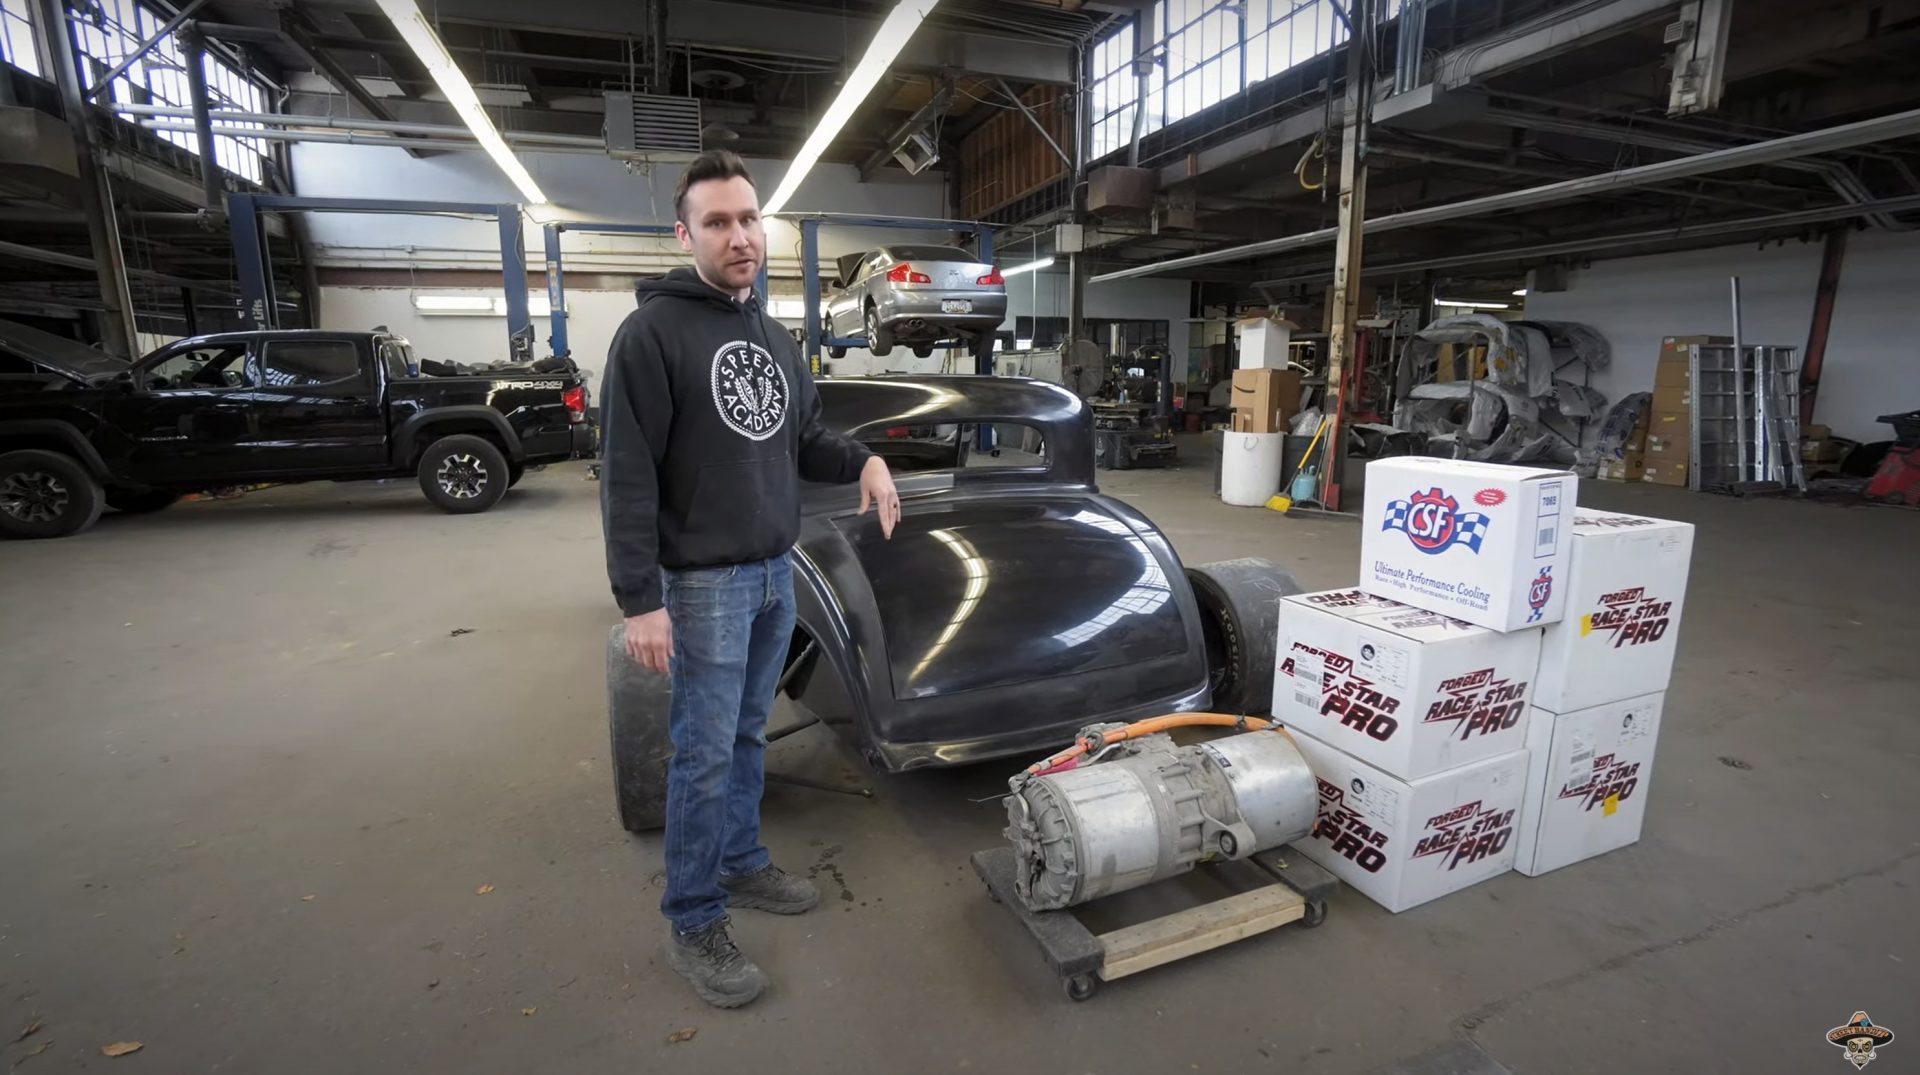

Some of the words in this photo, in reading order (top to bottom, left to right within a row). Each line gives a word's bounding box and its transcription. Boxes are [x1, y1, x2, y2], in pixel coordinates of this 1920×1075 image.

[721, 350, 775, 379] SPEED
[723, 389, 782, 431] ACADEMY
[1407, 502, 1449, 539] CSF
[1374, 560, 1405, 579] Ultimate
[1407, 569, 1455, 593] Performance
[1457, 582, 1491, 604] Cooling
[1375, 575, 1389, 585] Race
[1392, 578, 1407, 590] High
[1409, 581, 1449, 600] Performance
[1456, 596, 1489, 611] Off-Road
[1531, 581, 1548, 601] CSF
[1597, 590, 1638, 605] FORGED
[1591, 608, 1631, 627] RACE
[1633, 601, 1672, 620] STAR
[1614, 618, 1669, 648] PRO
[1340, 681, 1400, 714] STAR
[1437, 671, 1487, 693] FORGED
[1320, 693, 1398, 742] PRO
[1424, 693, 1479, 721] RACE
[1481, 682, 1528, 707] STAR
[1460, 700, 1525, 741] PRO
[1603, 762, 1640, 784] STAR
[1331, 810, 1389, 849] STAR
[1413, 825, 1466, 857] RACE
[1469, 809, 1515, 837] STAR
[1424, 804, 1474, 830] FORGED
[1312, 819, 1387, 873] PRO
[1447, 826, 1512, 871] PRO
